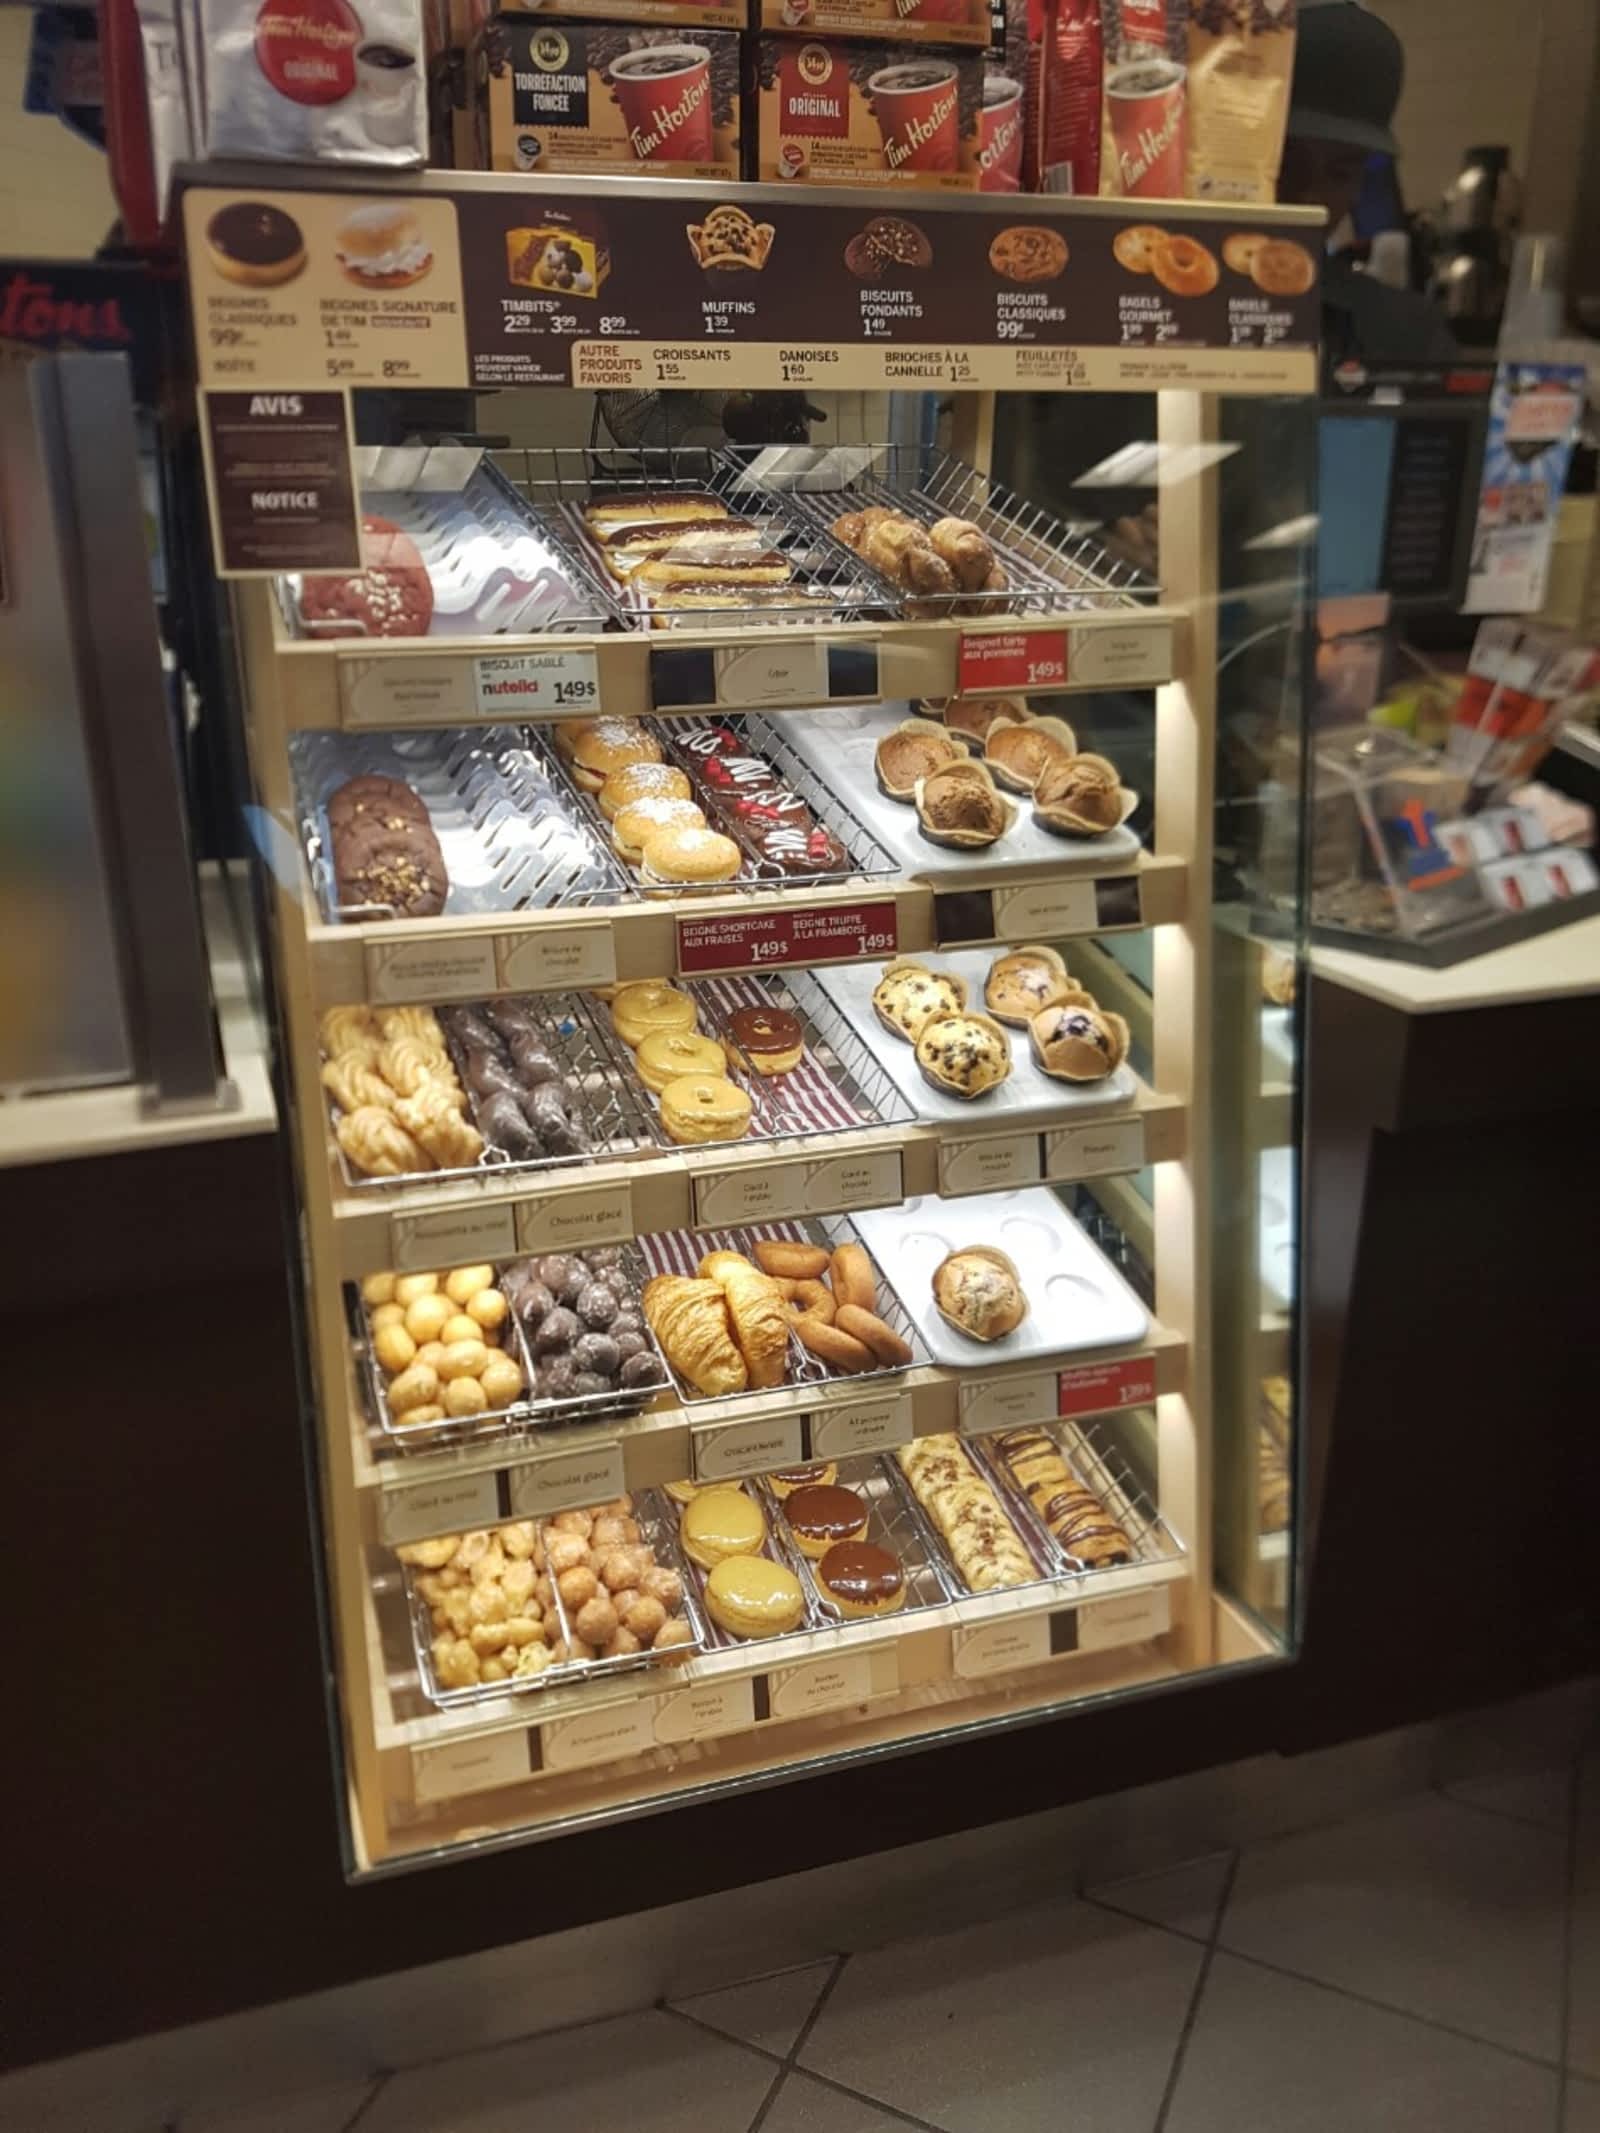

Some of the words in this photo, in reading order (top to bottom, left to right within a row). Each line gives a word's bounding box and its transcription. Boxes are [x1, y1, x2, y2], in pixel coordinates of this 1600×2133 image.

[789, 97, 840, 118] ORIGINAL
[630, 126, 662, 159] Tim
[883, 136, 912, 168] Tim
[860, 290, 913, 303] BISCUITS
[997, 294, 1048, 306] BISCUITS
[1119, 296, 1160, 309] BAGELS
[382, 300, 456, 315] SIGNATURE
[702, 302, 756, 314] MUFFINS
[861, 305, 922, 317] FONDANTS
[321, 315, 339, 328] DE
[343, 315, 366, 327] TIM
[997, 308, 1066, 322] CLASSIQUES
[1119, 310, 1172, 323] GOURMET
[579, 345, 620, 357] AUTRE
[653, 349, 731, 361] CROISSANTS
[779, 351, 839, 362] DANOISES
[885, 352, 941, 363] BRIOCHES
[945, 349, 952, 363] À
[955, 353, 968, 363] LA
[1016, 348, 1078, 362] FEUILLETÉS
[474, 355, 489, 364] LES
[491, 355, 531, 364] PRODUITS
[579, 359, 642, 371] PRODUITS
[515, 373, 565, 382] RESTAURANT
[885, 365, 943, 377] CANNELLE
[580, 372, 632, 384] FAVORIS
[249, 395, 303, 416] AVIS
[251, 491, 318, 510] NOTICE
[480, 658, 525, 671] BISCUIT
[482, 680, 538, 696] nutella
[793, 917, 827, 929] BEIGNE
[829, 914, 861, 926] TRUFFE
[683, 924, 718, 937] BEIGNE
[719, 920, 776, 935] SHORTCAKE
[802, 929, 815, 940] LA
[815, 925, 867, 938] FRAMBOISE
[684, 936, 702, 947] AUX
[704, 934, 744, 945] FRAISES
